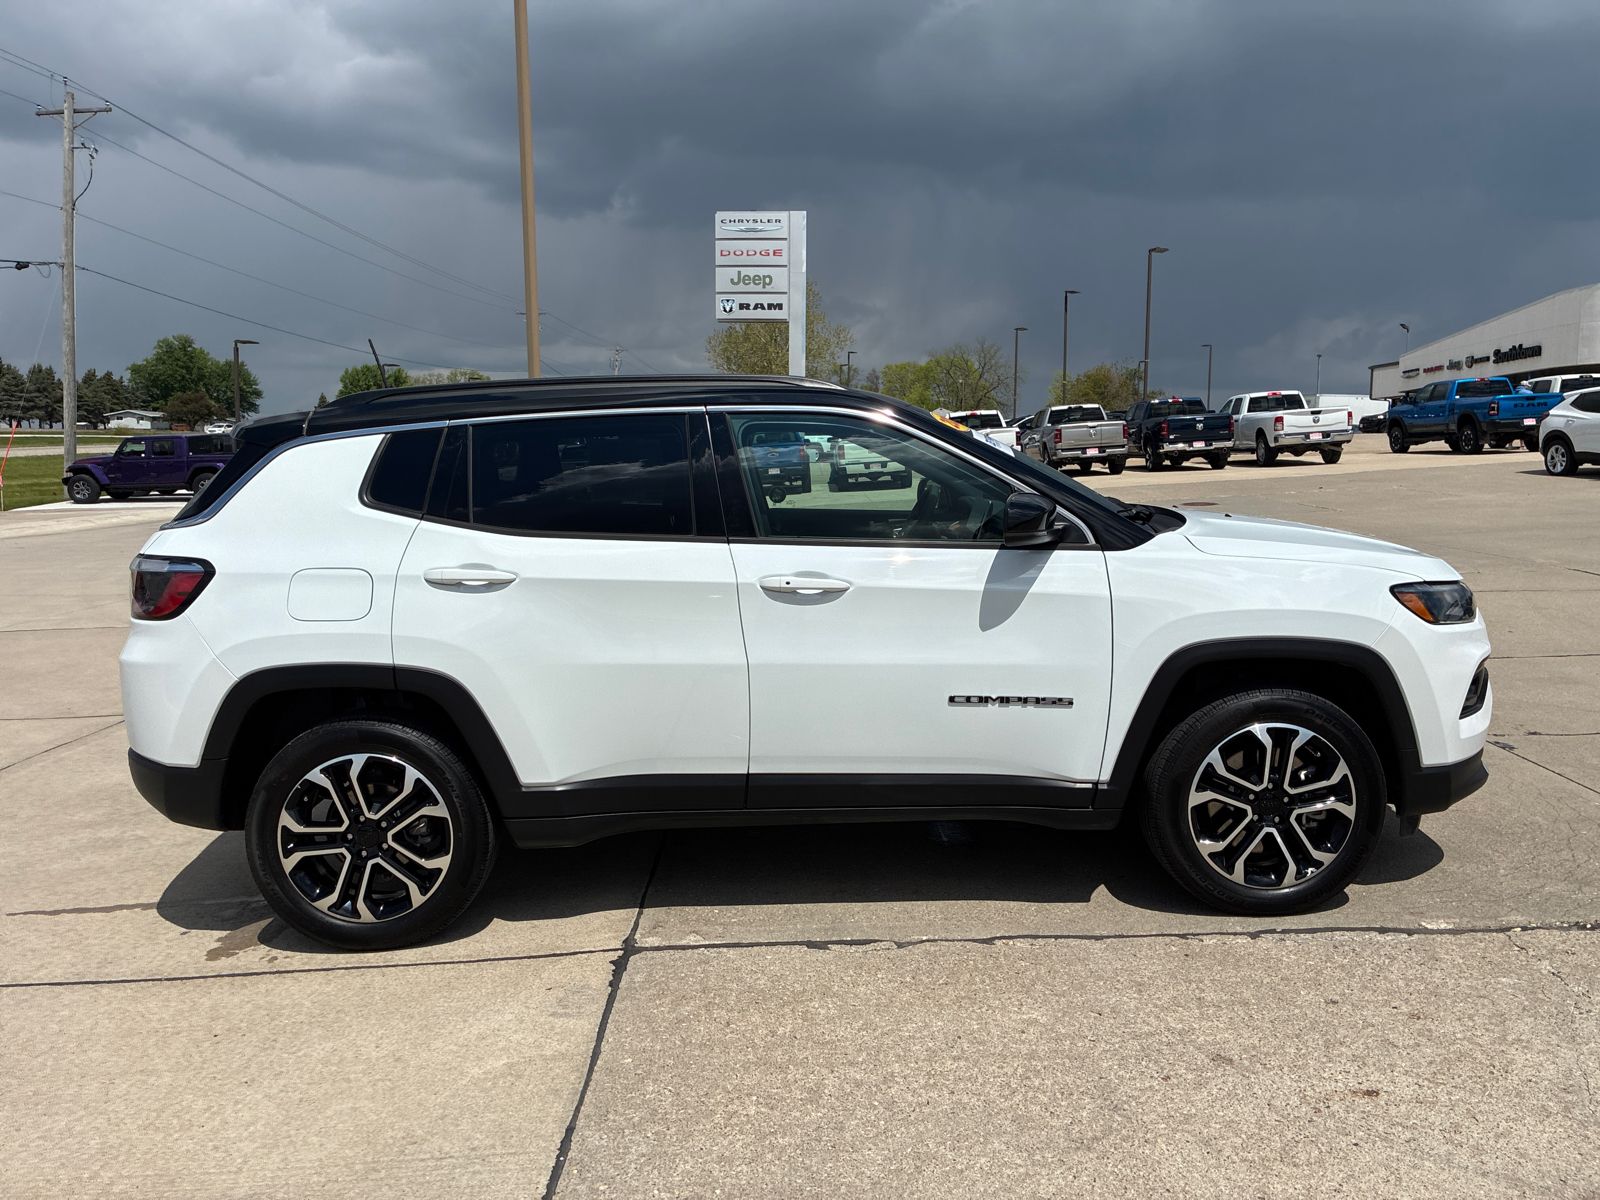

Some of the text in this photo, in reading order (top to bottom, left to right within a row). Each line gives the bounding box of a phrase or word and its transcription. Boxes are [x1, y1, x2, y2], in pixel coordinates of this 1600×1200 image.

[720, 249, 783, 257] DODGE
[730, 270, 773, 289] Jeep
[738, 302, 783, 311] RAM
[948, 695, 1074, 707] COMPASS
